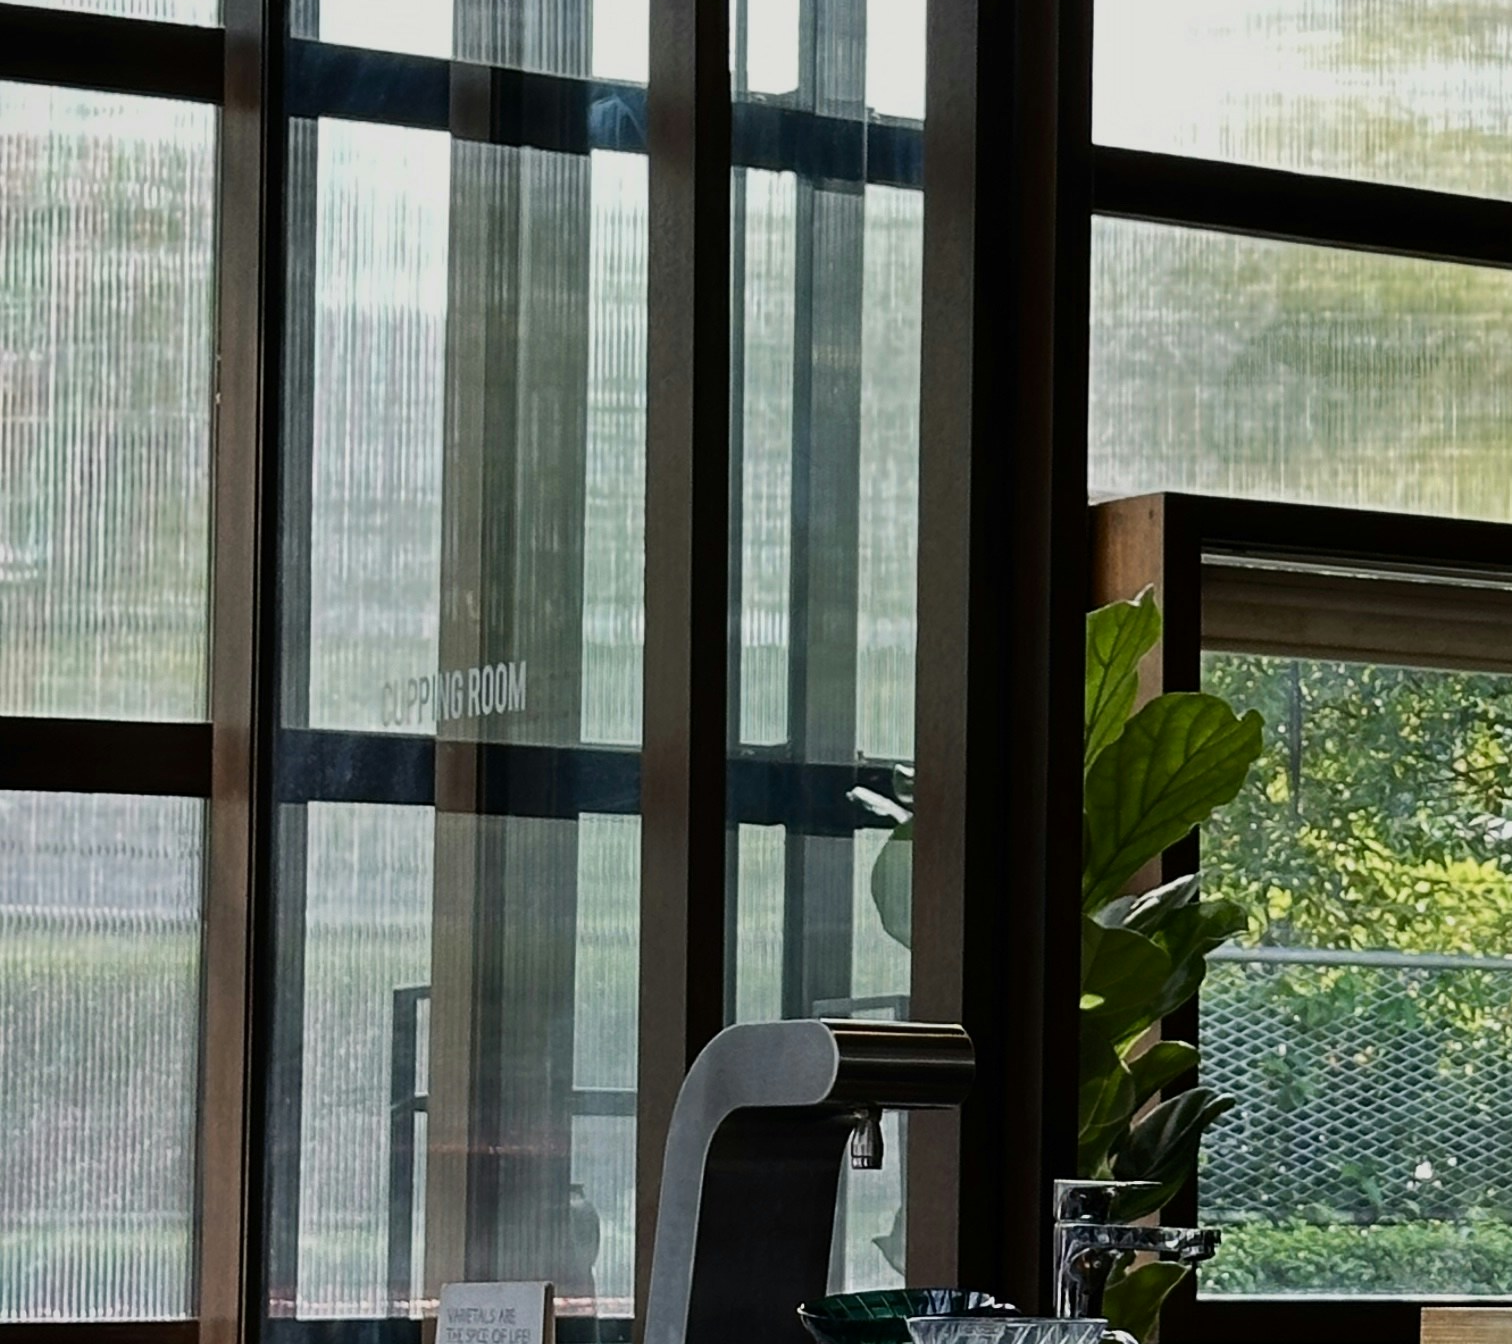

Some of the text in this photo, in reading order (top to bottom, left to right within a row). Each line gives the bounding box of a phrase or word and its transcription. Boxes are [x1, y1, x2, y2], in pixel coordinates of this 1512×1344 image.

[381, 661, 527, 727] CUPPING ROOM
[446, 1328, 464, 1344] THE
[492, 1329, 507, 1344] OF
